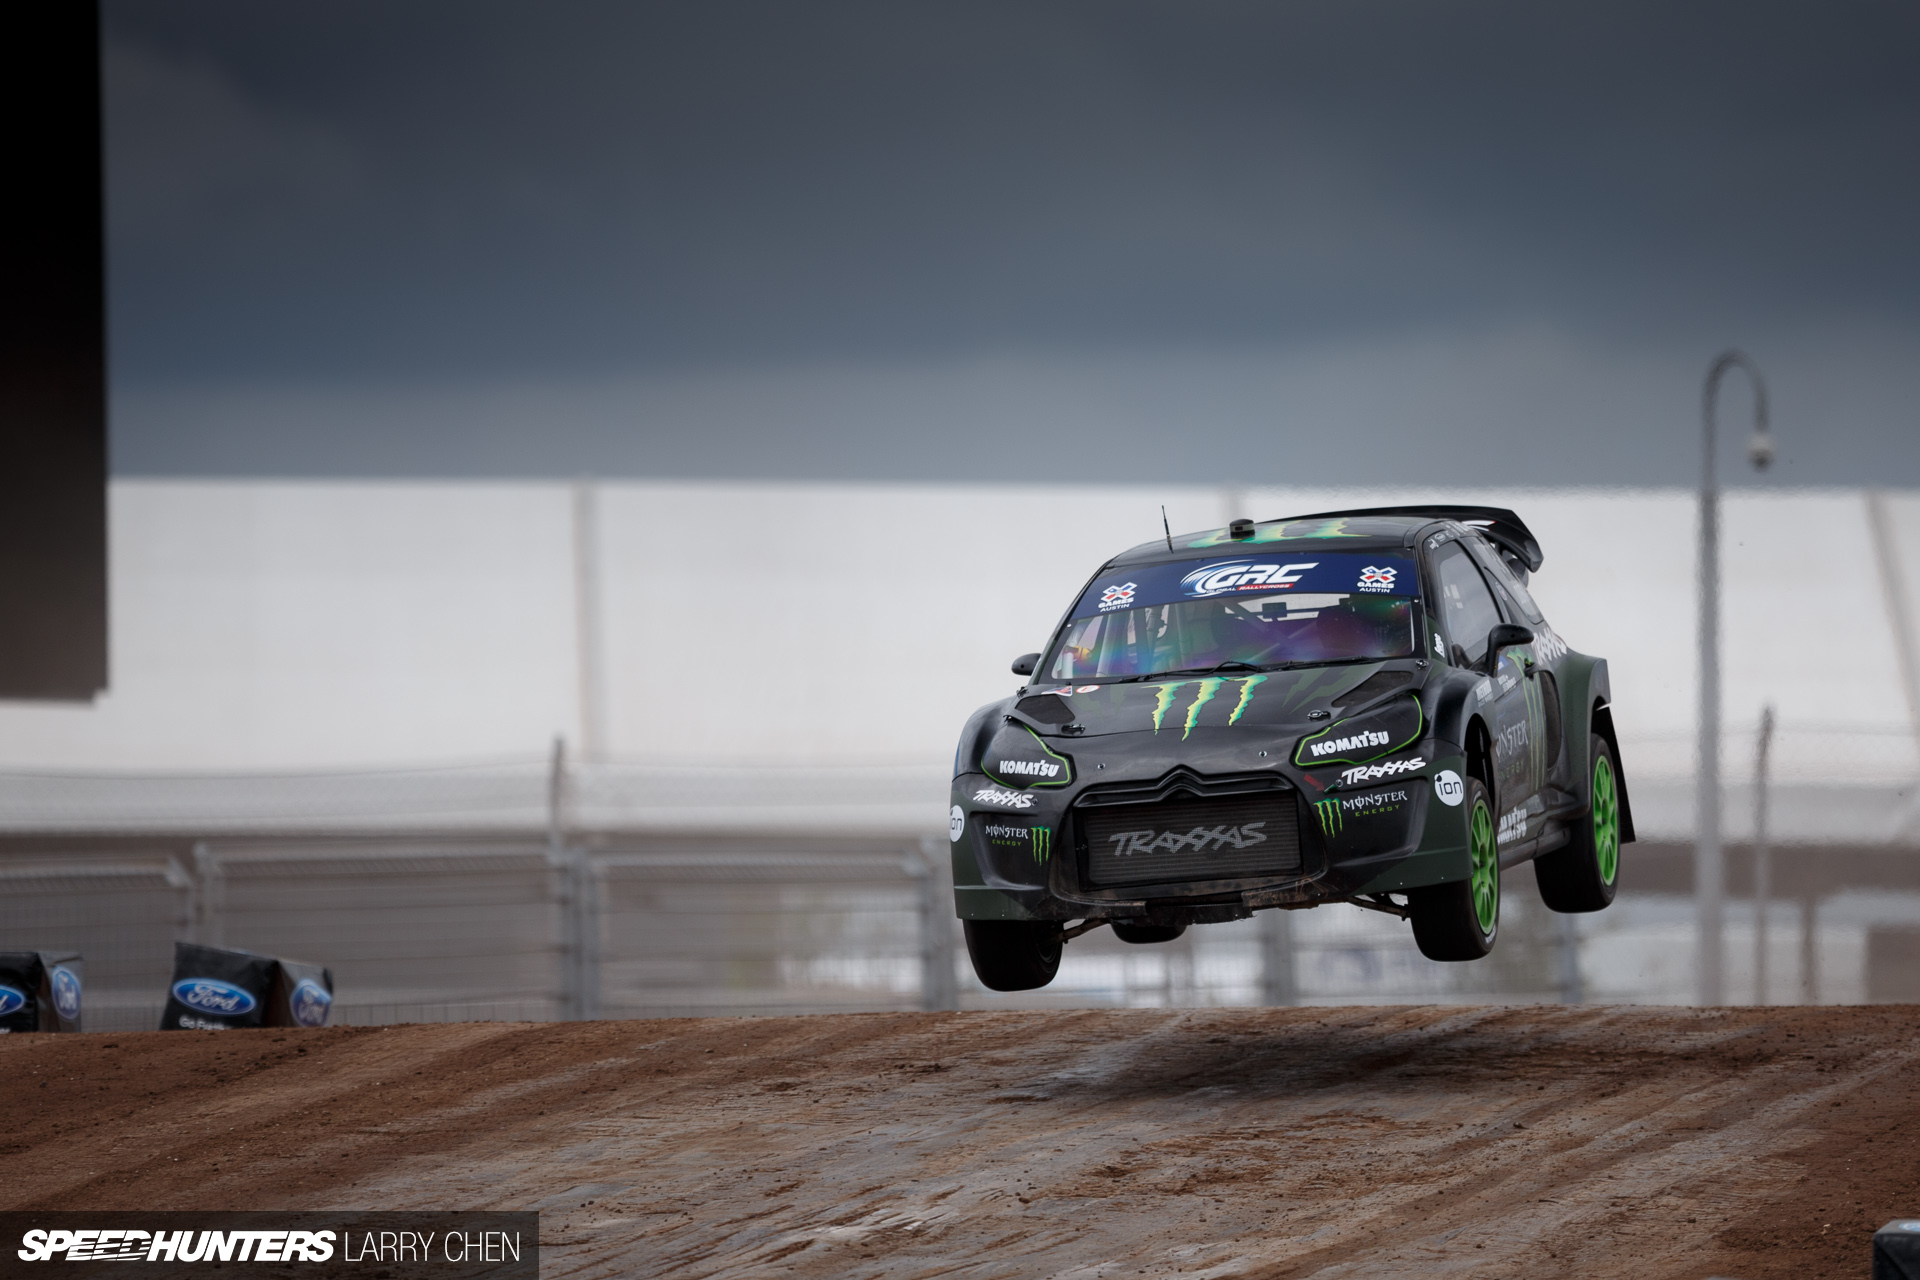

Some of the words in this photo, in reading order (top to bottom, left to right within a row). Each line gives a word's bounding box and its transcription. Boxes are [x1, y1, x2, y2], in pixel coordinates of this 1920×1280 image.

[1202, 562, 1319, 591] GRC
[1238, 583, 1291, 591] RALLYCROSS
[1357, 581, 1395, 589] GAMES
[1098, 597, 1134, 608] GAMES
[1100, 603, 1130, 613] AUSTIN
[1310, 730, 1390, 757] KOMATSU
[1000, 759, 1060, 777] KOMATSU
[1341, 757, 1427, 785] TRAXXAS
[1437, 781, 1463, 797] ion
[973, 789, 1034, 808] TRAXXAS
[1342, 790, 1408, 810] MONSTER
[1355, 804, 1400, 817] ENERGY
[985, 824, 1029, 840] MONSTER
[1108, 821, 1267, 857] TRAXXAS
[992, 839, 1022, 847] ENERGY
[187, 983, 241, 1012] Ford
[179, 1014, 195, 1029] Go
